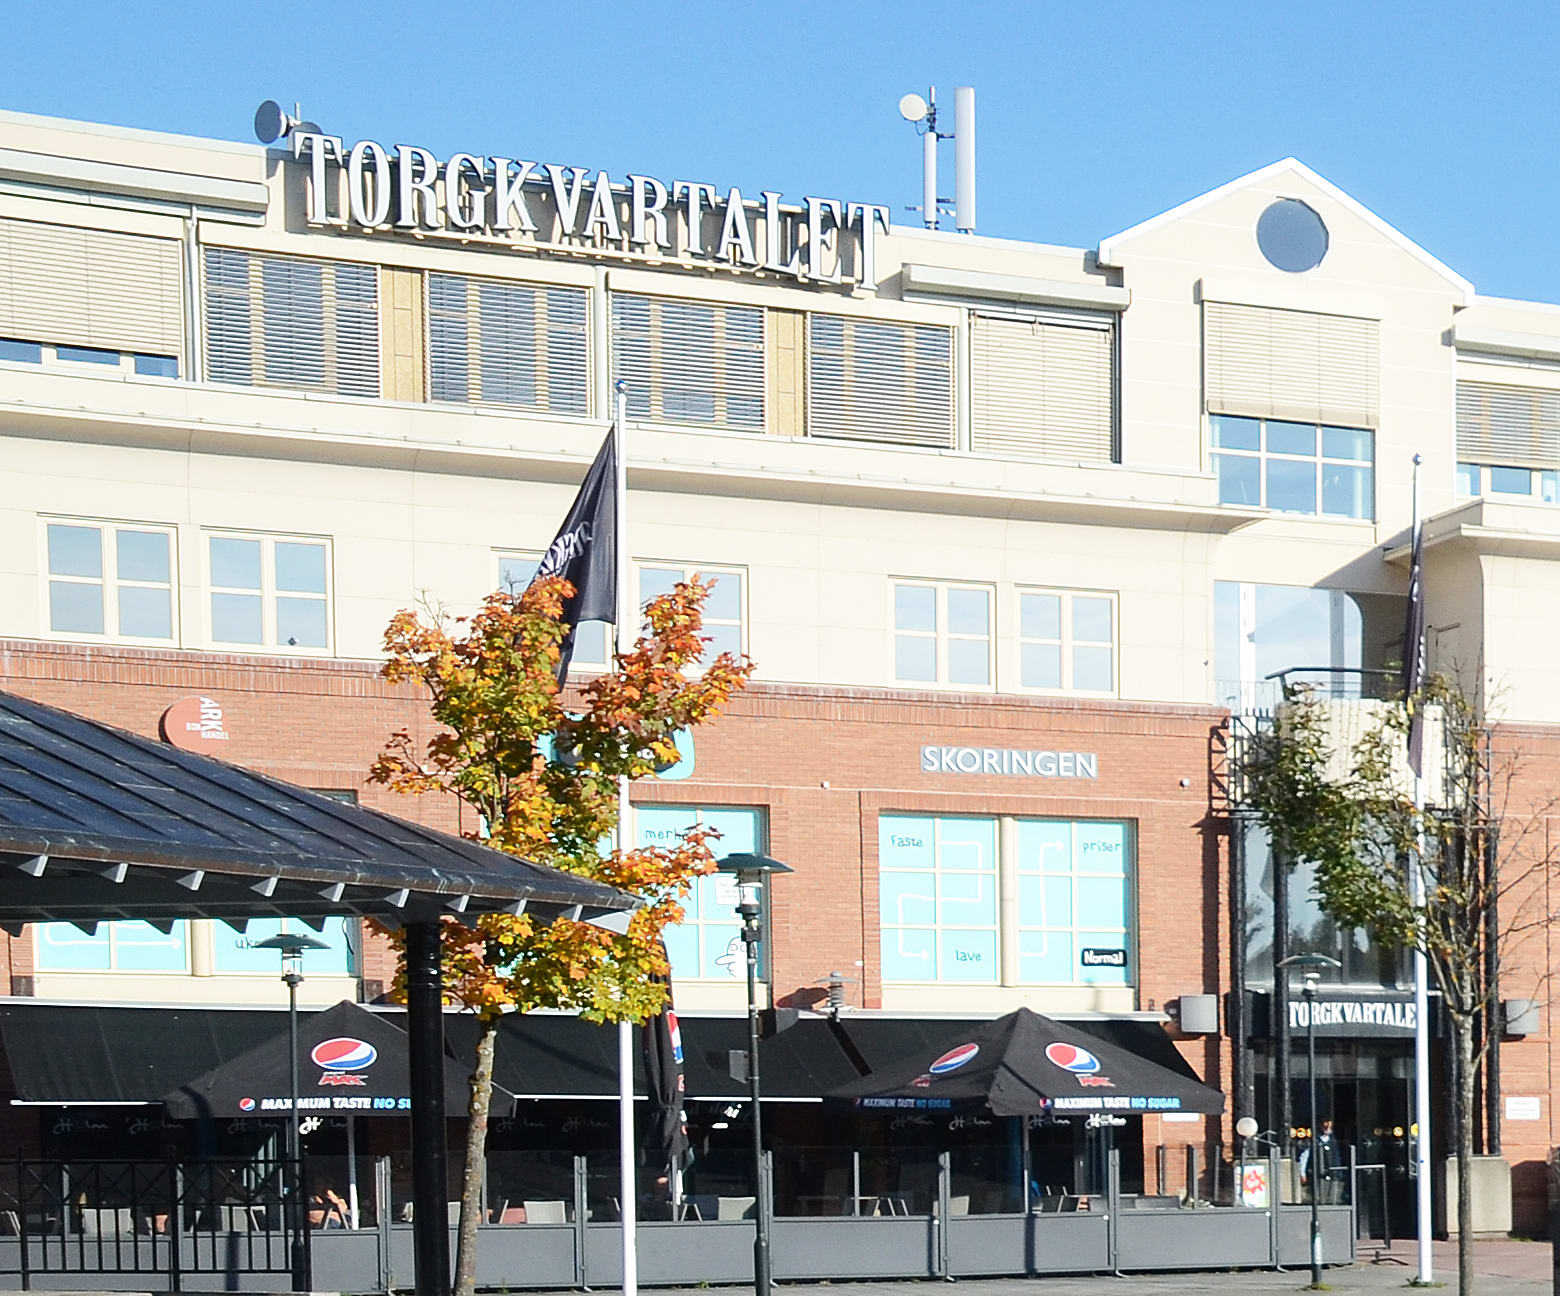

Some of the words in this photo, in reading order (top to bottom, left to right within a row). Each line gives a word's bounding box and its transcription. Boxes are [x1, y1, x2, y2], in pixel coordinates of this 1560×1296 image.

[293, 131, 890, 291] TORGKVARTALET
[200, 697, 223, 732] ARK
[922, 747, 1096, 778] SKORINGEN
[955, 950, 982, 962] lave
[1084, 950, 1124, 964] Normal
[1289, 1002, 1417, 1028] TORGKVARTALE
[261, 1098, 331, 1110] MAXMUM
[333, 1097, 372, 1109] TASTE
[373, 1098, 396, 1109] NO
